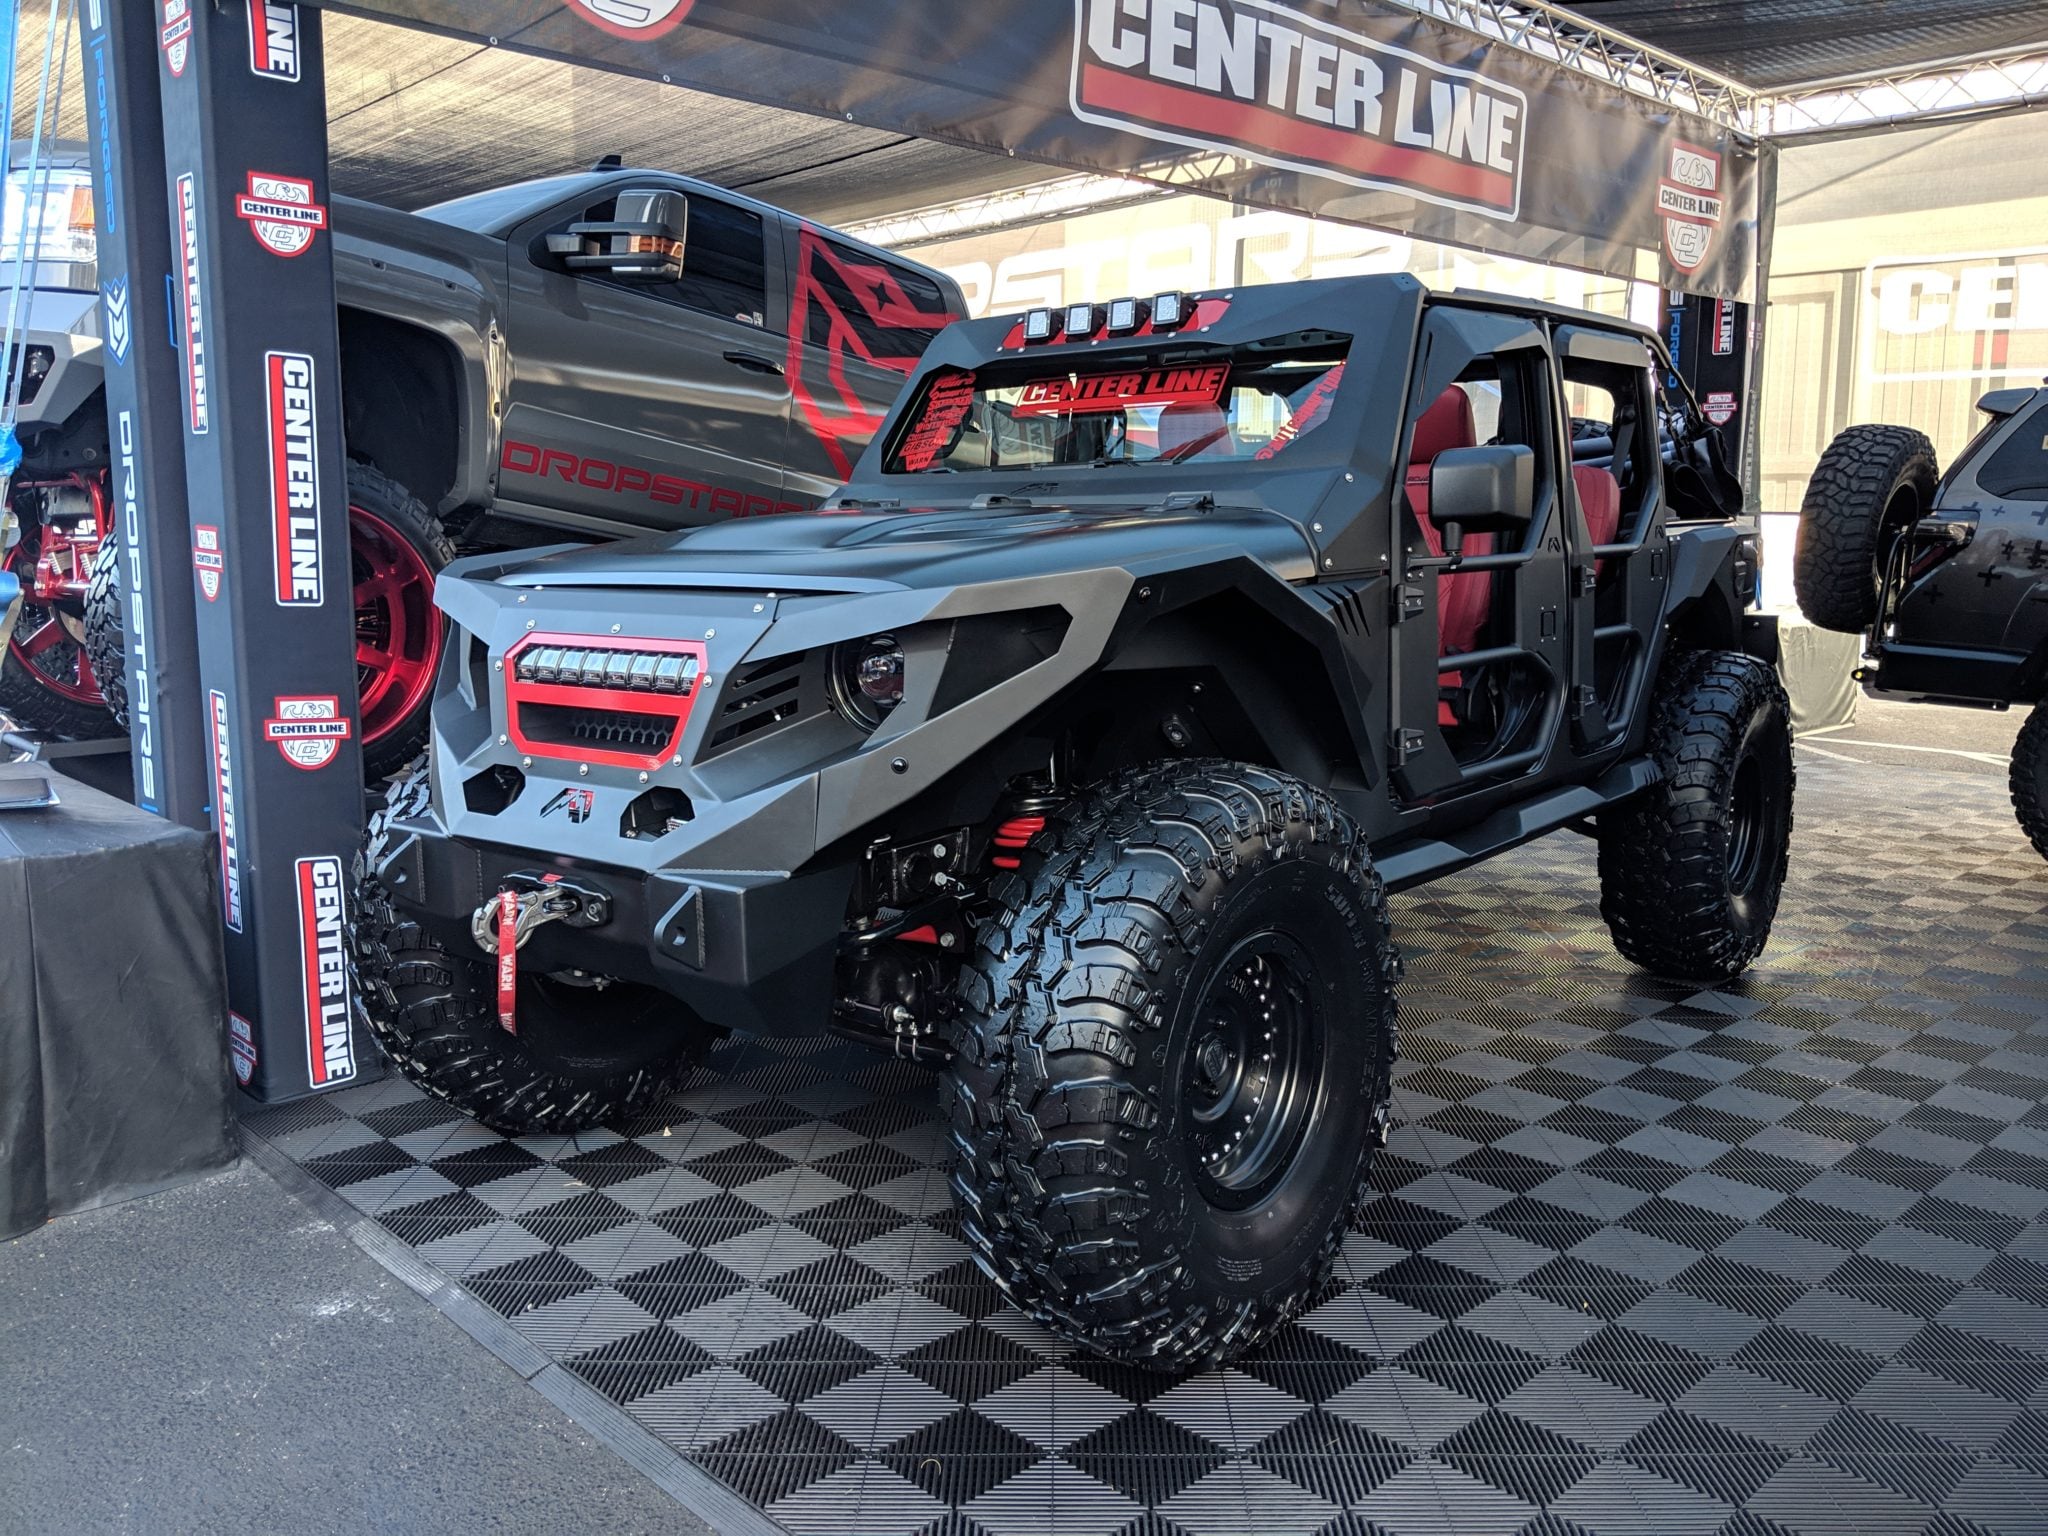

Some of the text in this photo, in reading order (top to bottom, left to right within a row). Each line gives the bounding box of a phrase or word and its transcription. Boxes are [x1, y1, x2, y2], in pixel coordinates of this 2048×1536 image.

[265, 0, 294, 75] INE
[1088, 0, 1518, 173] CENTER LINE
[95, 48, 115, 234] FORGED
[244, 202, 320, 222] CENTER LINE
[1661, 190, 1720, 217] CENTER LINE
[183, 179, 208, 428] CENTER LINE
[1719, 316, 1732, 353] LINE
[1024, 367, 1224, 402] CENTER LINE
[283, 358, 318, 601] CENTER LINE
[908, 456, 930, 467] WARN
[119, 411, 156, 799] DROPSTARS
[272, 723, 345, 734] CENTER LINE
[216, 695, 242, 928] CENTER LINE
[502, 891, 514, 926] WARN
[311, 862, 353, 1081] CENTER LINE
[501, 953, 513, 992] WARN
